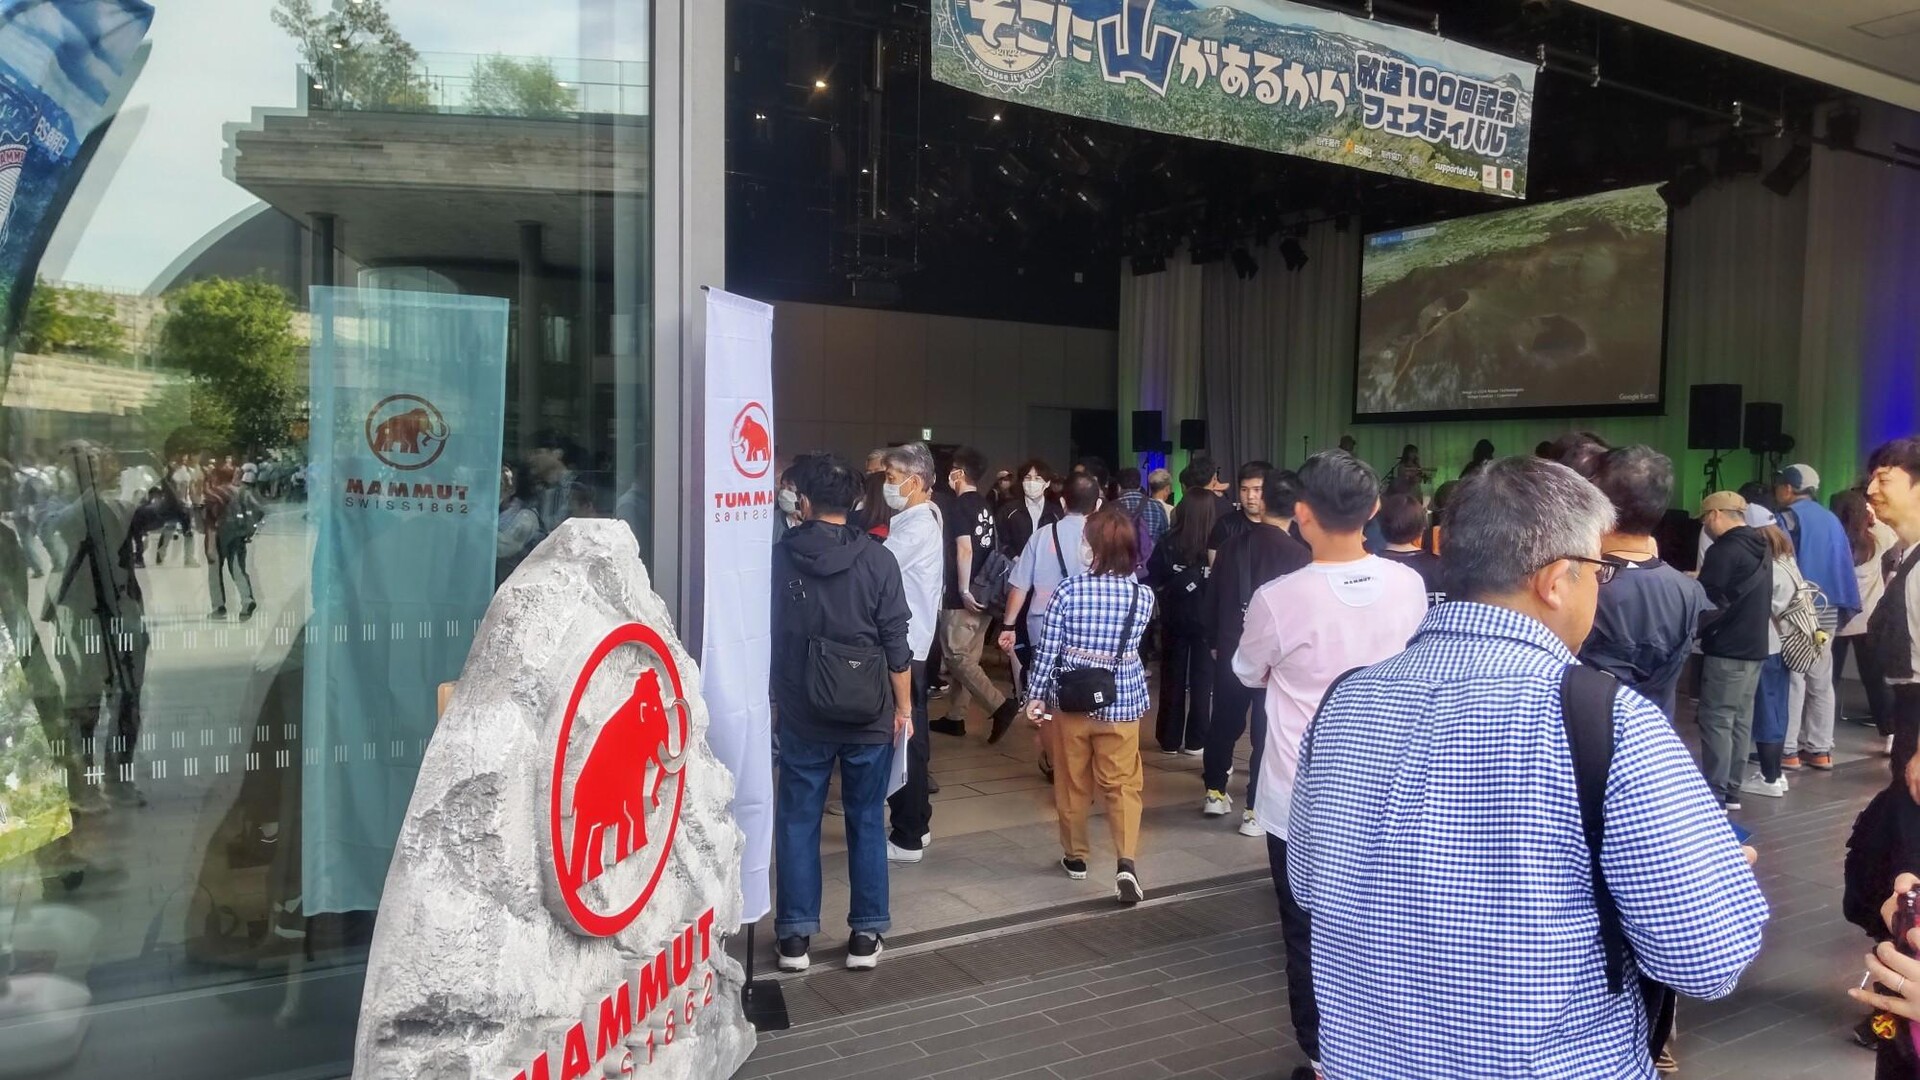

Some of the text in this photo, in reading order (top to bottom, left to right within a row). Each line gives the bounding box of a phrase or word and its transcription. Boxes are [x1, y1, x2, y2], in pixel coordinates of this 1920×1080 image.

[974, 58, 1009, 81] Because
[1026, 62, 1046, 78] there
[1356, 53, 1518, 127] 放送100回記念
[1364, 93, 1507, 156] フェスティバル
[1434, 162, 1479, 180] supported by
[345, 478, 469, 500] MAMMUT
